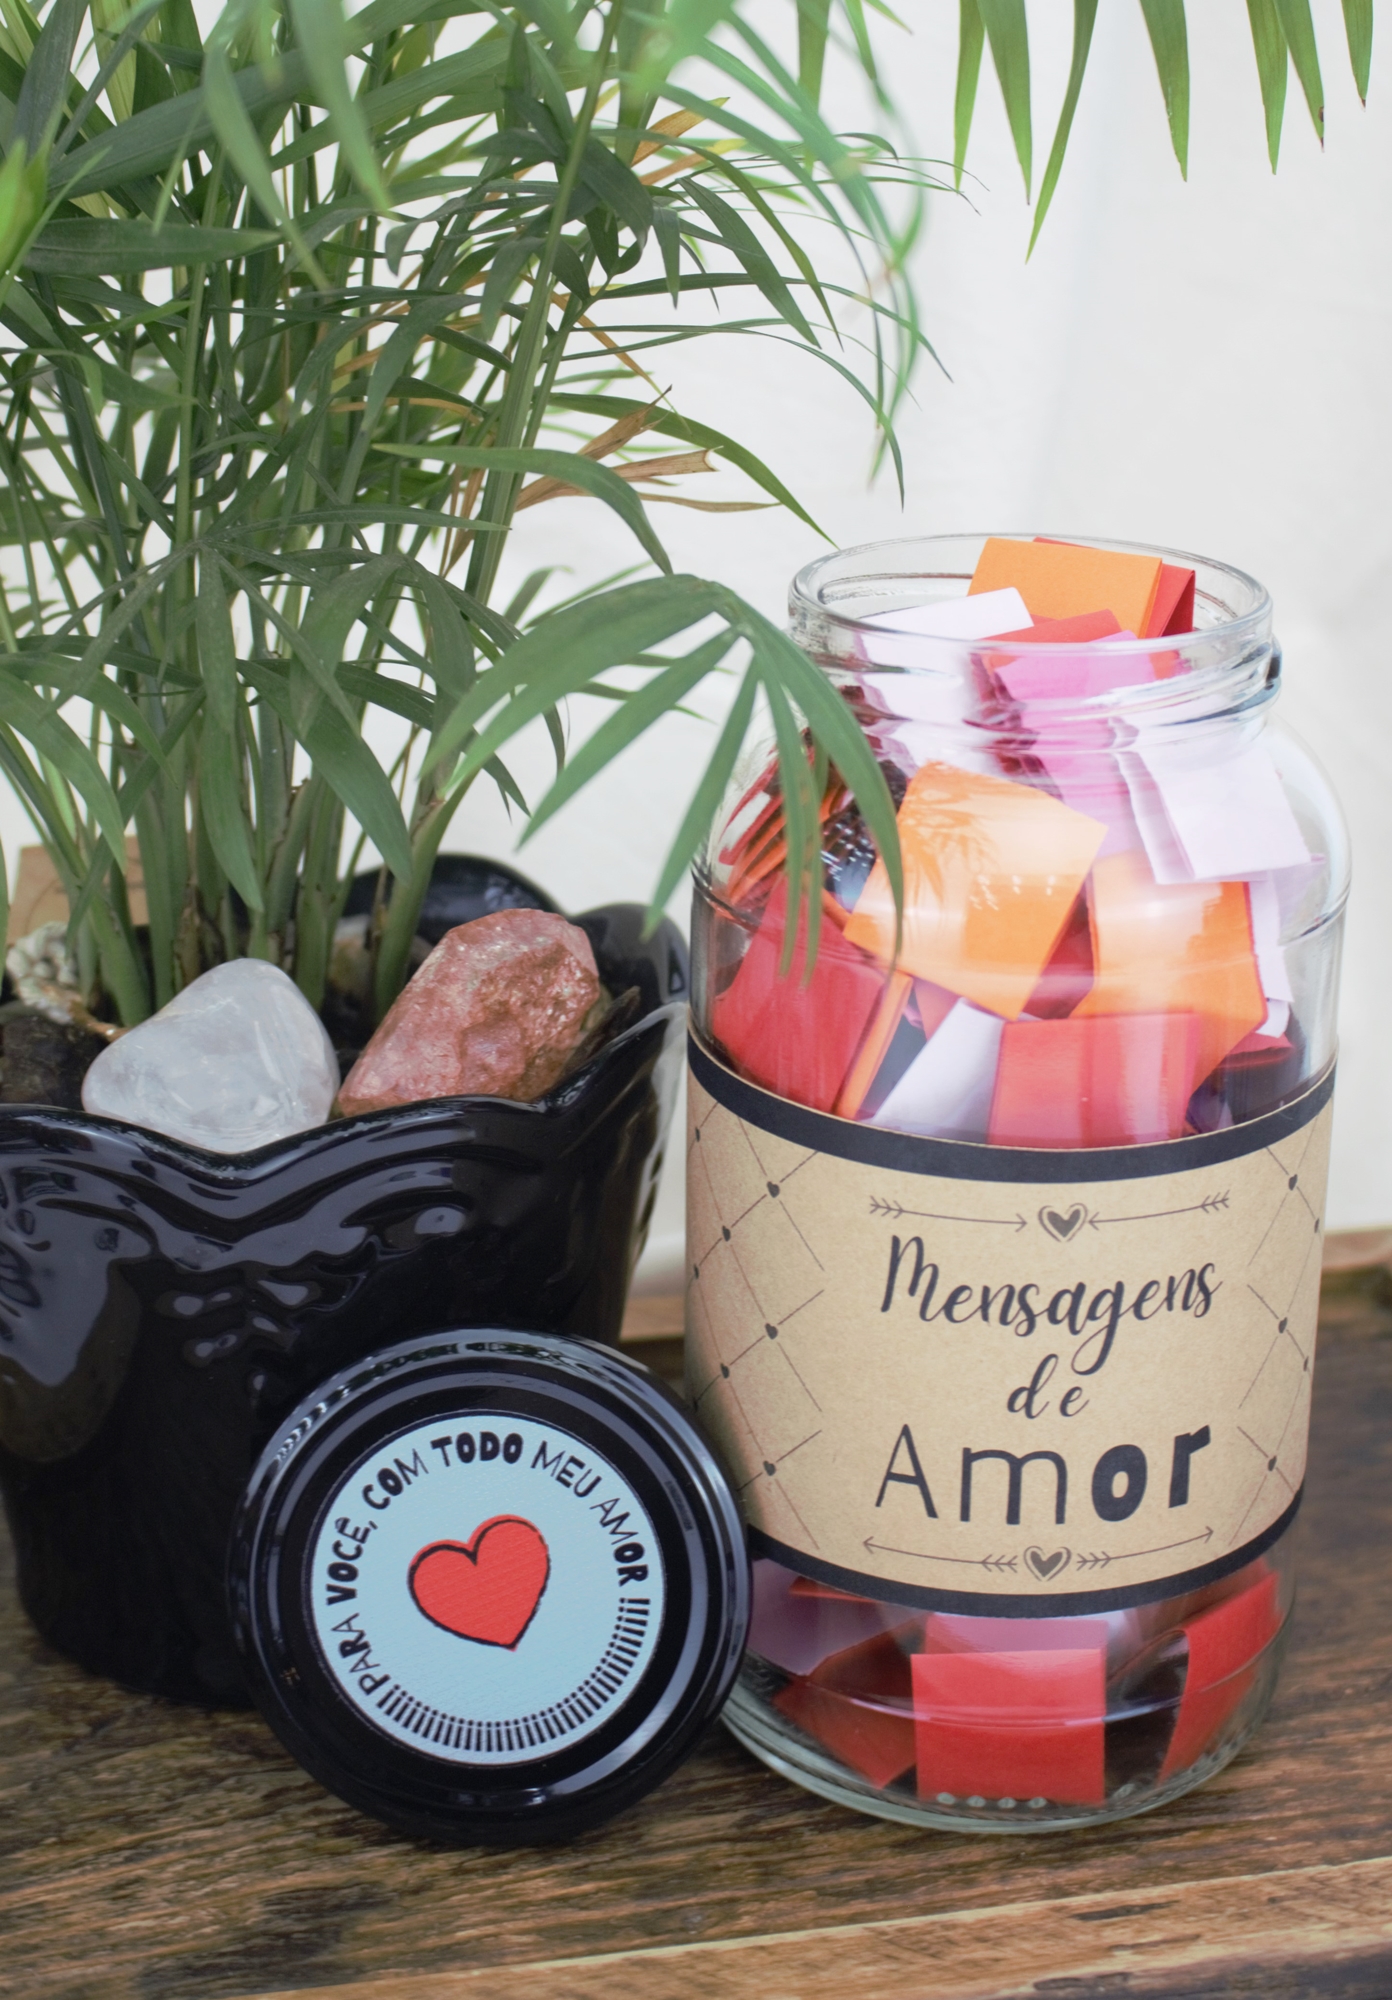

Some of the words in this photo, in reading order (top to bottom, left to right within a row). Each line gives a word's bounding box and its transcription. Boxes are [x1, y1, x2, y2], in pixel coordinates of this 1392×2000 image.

[880, 1234, 1223, 1376] Mensagens
[1006, 1353, 1090, 1420] de
[874, 1423, 1211, 1526] Amor
[331, 1613, 391, 1696] PARA
[362, 1448, 430, 1510] COM
[430, 1431, 524, 1467] TODO
[530, 1440, 603, 1498] MEU
[589, 1497, 649, 1587] AMOR
